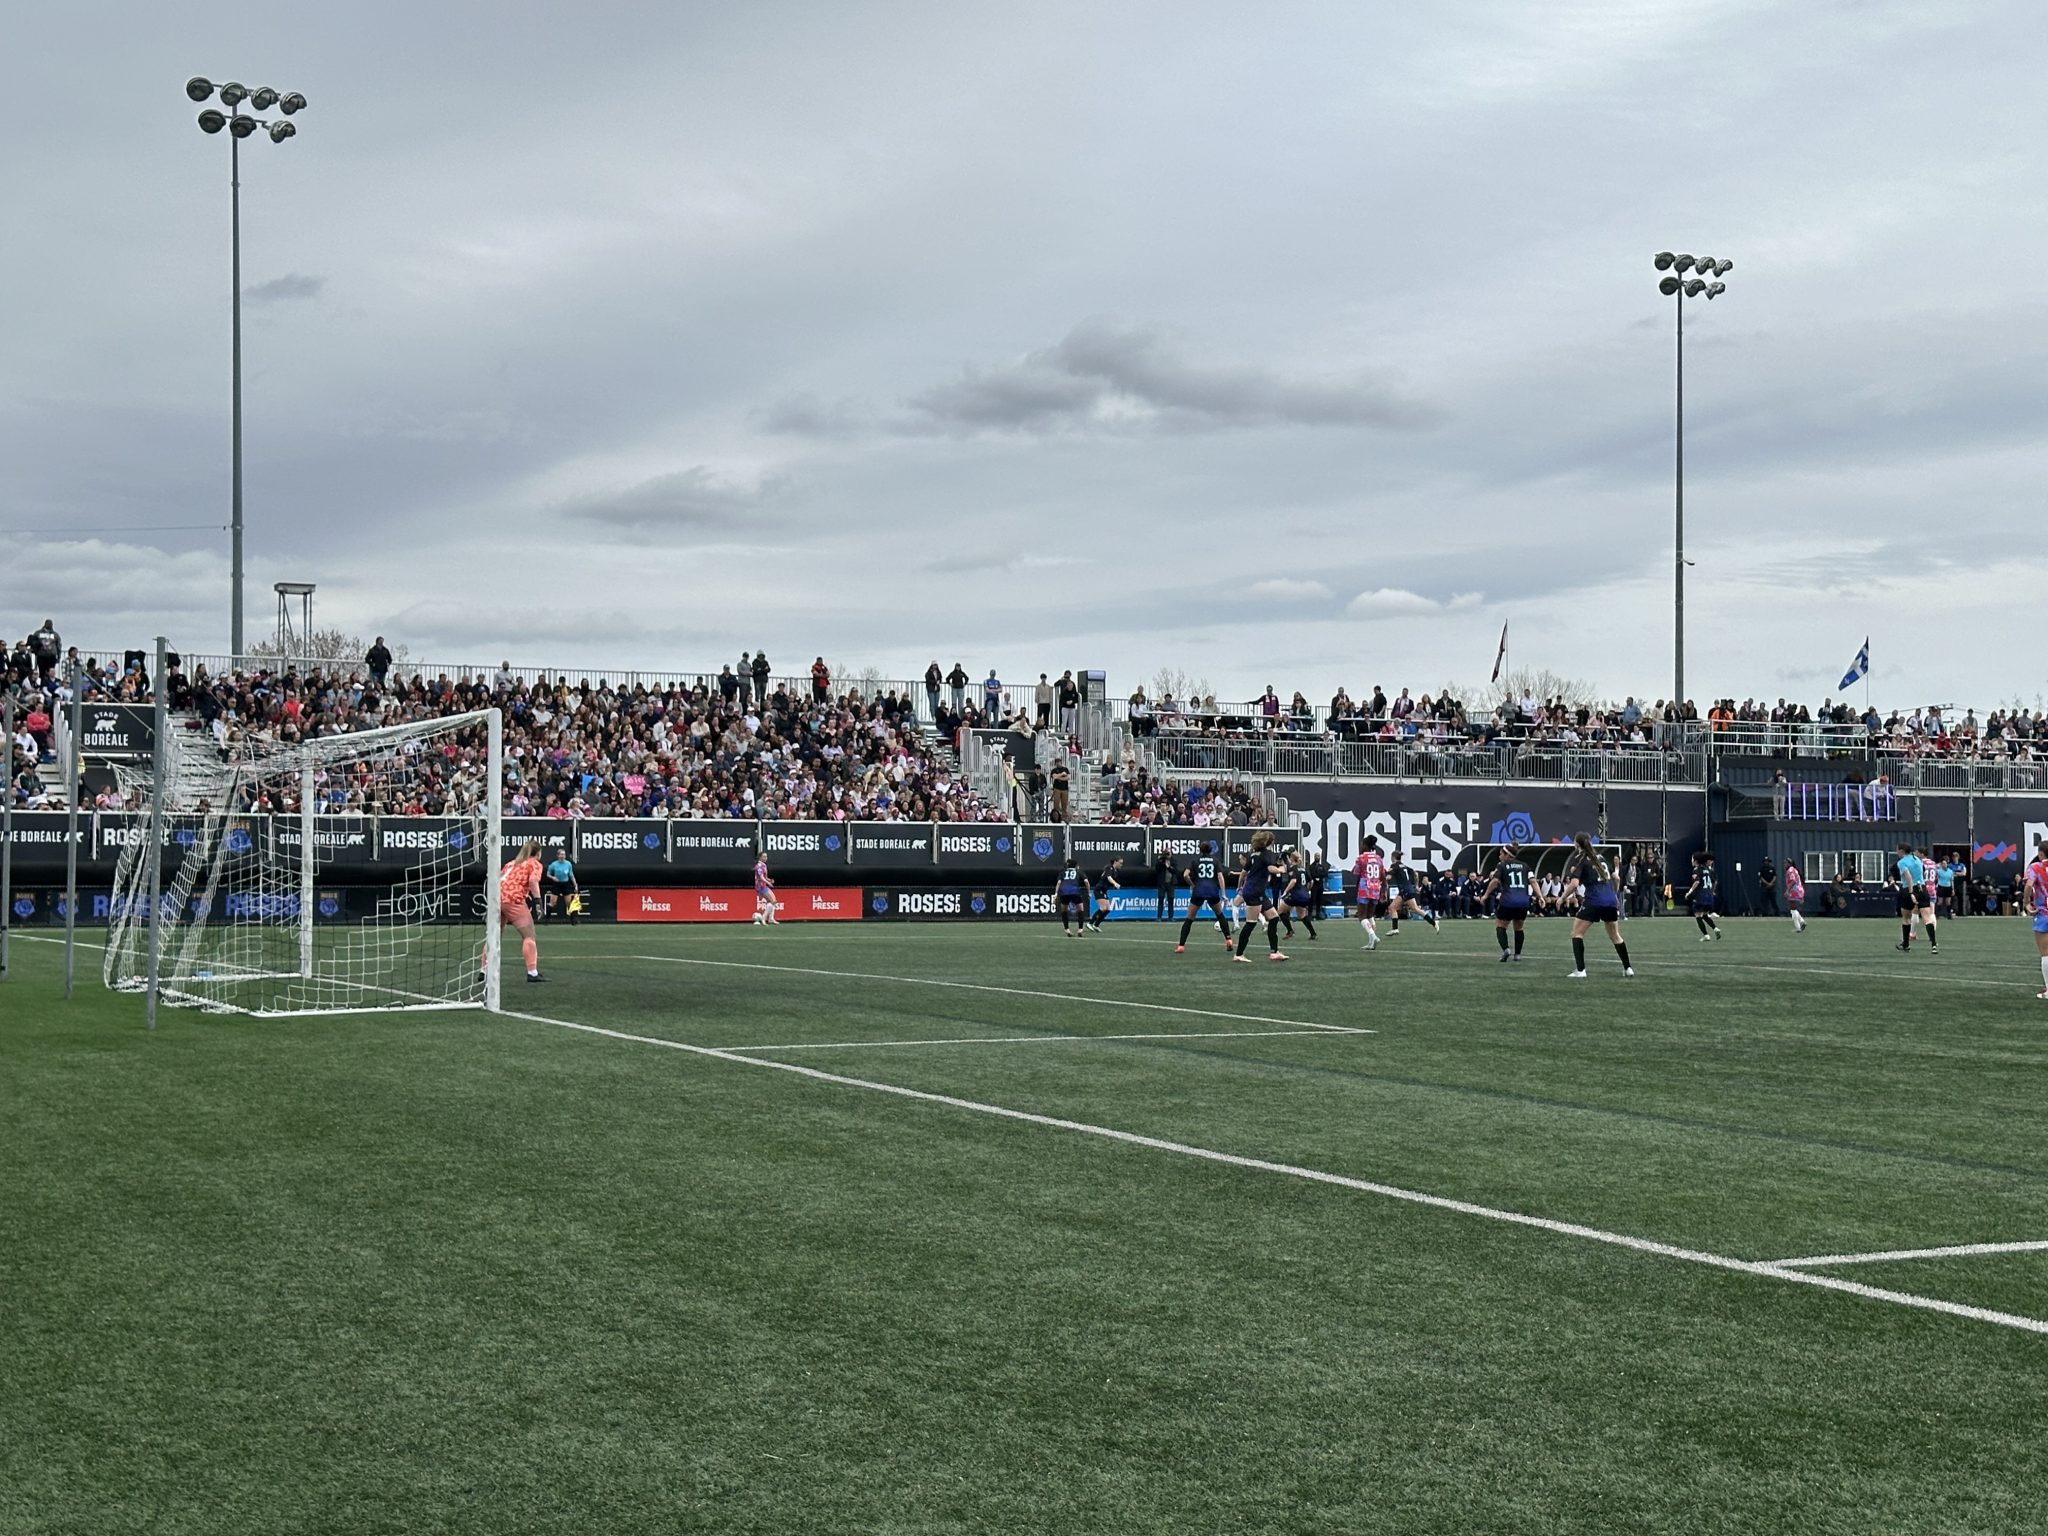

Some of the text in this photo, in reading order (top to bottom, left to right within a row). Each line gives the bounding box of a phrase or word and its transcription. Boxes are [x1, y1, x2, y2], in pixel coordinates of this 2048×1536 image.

[94, 711, 119, 720] STADE
[84, 733, 129, 746] BORÉALE
[279, 833, 346, 845] STAD ORÉALE
[582, 832, 632, 849] ROSES
[676, 836, 700, 848] STADE
[767, 834, 814, 851] ROSES
[856, 838, 878, 849] STADE
[941, 836, 986, 853] ROSES
[1289, 809, 1463, 873] ROSES
[1074, 840, 1095, 851] STADE
[1198, 863, 1215, 879] 33
[1508, 871, 1525, 888] 11
[642, 895, 653, 903] LA
[700, 895, 710, 903] LA
[812, 895, 822, 903] LA
[898, 893, 955, 913] ROSES
[995, 894, 1051, 914] ROSES
[642, 902, 671, 911] PRESSE
[700, 902, 728, 911] PRESSE
[757, 902, 784, 911] PRSE
[812, 902, 840, 910] PRESSE
